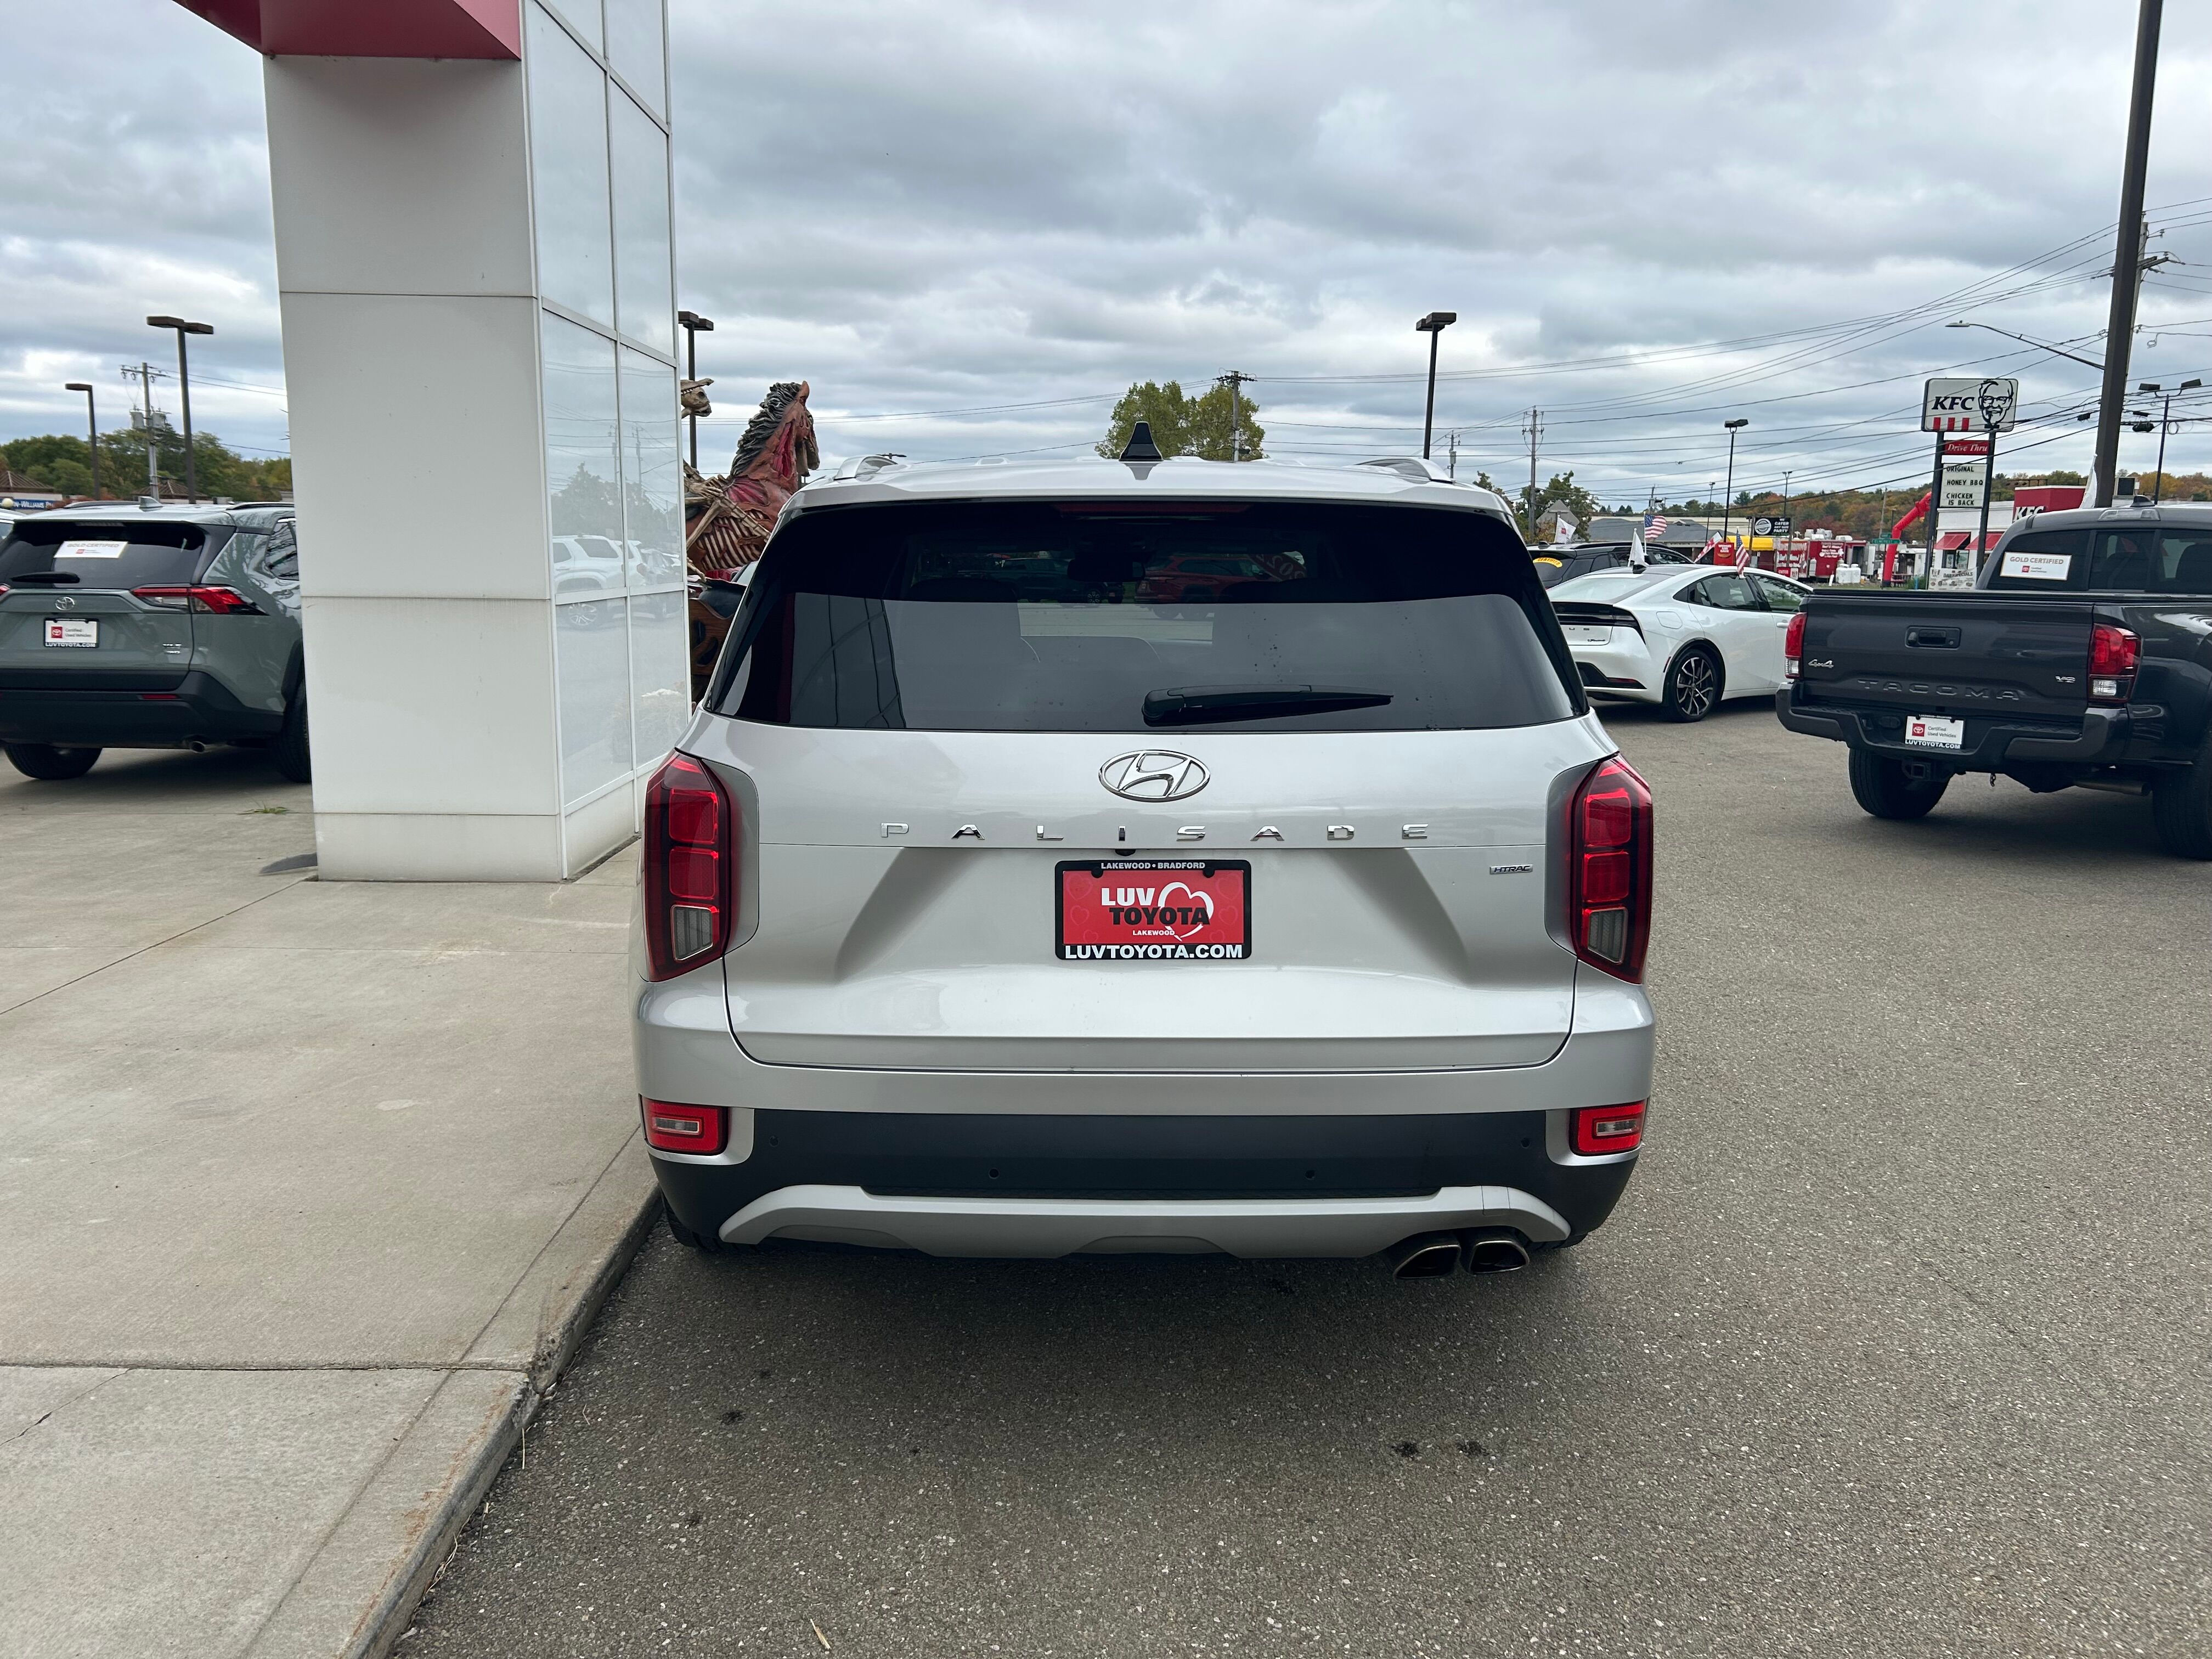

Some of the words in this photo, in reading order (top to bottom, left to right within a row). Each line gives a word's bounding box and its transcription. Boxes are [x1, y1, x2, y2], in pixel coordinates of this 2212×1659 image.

[1931, 396, 1975, 410] KFC
[1948, 443, 1967, 452] Drive
[1970, 443, 1988, 452] Thru
[1857, 679, 2019, 701] TACOMA
[1905, 739, 1960, 749] LUVTOYOTA.COM
[881, 822, 1429, 842] PALISADE
[1101, 887, 1155, 906] LUV
[1109, 907, 1210, 925] TOYOTA
[1065, 944, 1243, 959] LUVTOYOTA.COM
